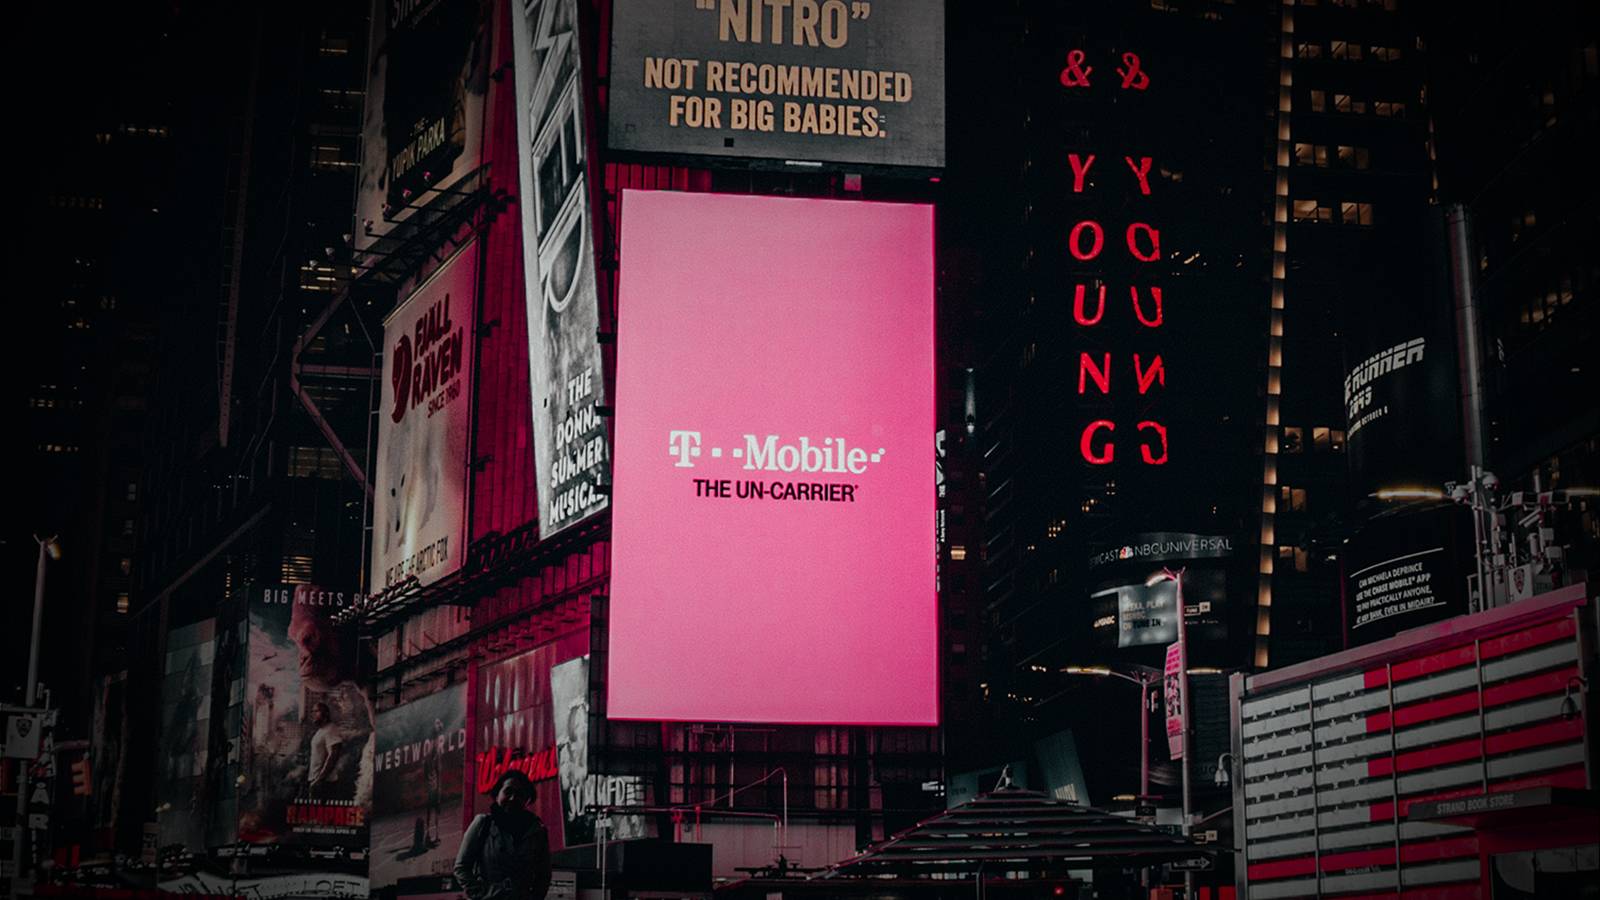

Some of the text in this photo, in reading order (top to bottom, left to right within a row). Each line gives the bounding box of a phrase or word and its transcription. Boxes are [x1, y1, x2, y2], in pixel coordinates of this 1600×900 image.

[643, 57, 913, 103] NOT RECOMMENDED
[669, 95, 722, 129] FOR
[730, 98, 775, 132] BIG
[416, 116, 446, 162] PARKA
[1351, 337, 1425, 393] RUNNER
[568, 367, 592, 406] THE
[550, 435, 604, 489] SUMMER
[693, 479, 731, 498] THE
[1134, 538, 1233, 557] NBCUNIVERSAL
[1416, 572, 1432, 584] APP
[263, 588, 289, 604] BIG
[298, 590, 344, 607] MEETS
[374, 728, 467, 773] WESTWORLD
[1437, 793, 1516, 816] STRAND BOOK STORE
